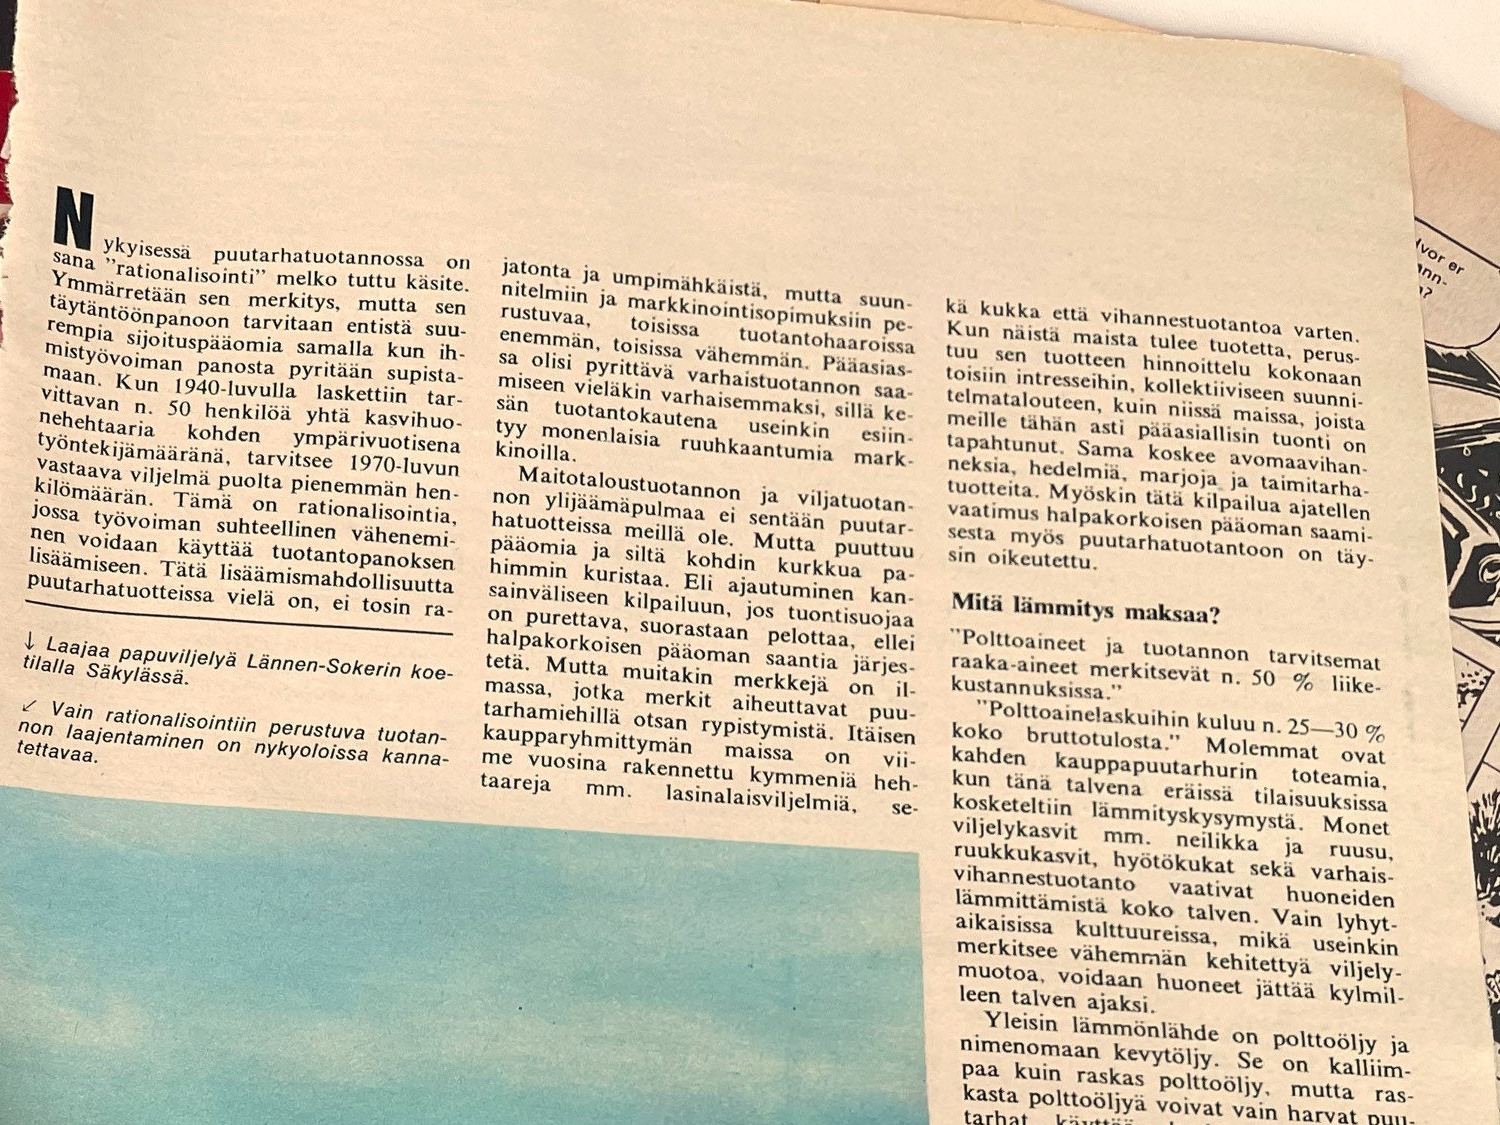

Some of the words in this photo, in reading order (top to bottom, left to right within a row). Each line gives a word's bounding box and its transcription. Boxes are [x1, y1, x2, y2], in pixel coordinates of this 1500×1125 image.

[213, 248, 424, 267] puutarhatuotannossa
[447, 258, 470, 270] on
[502, 257, 571, 279] jatonta
[582, 265, 600, 284] ja
[613, 272, 767, 300] umpimähkäistä,
[786, 289, 842, 304] mutta
[860, 295, 912, 310] suun-
[947, 298, 968, 314] kä
[981, 300, 1040, 319] kukka
[1053, 307, 1088, 321] että
[1101, 308, 1282, 335] vihannestuotantoa
[1294, 326, 1359, 343] varten.
[43, 365, 101, 386] maan.
[116, 373, 158, 392] Kun
[176, 378, 297, 398] 1940-luvulla
[317, 384, 407, 404] laskettiin
[427, 391, 462, 406] tar-
[519, 465, 740, 500] Maitotaloustuotannon
[760, 486, 779, 506] ja
[798, 489, 913, 512] viljatuotan-
[29, 546, 147, 575] lisäämiseen.
[160, 560, 207, 578] Tätä
[220, 564, 454, 594] lisäämismahdollisuutta
[952, 592, 1003, 612] Mitä
[1013, 595, 1114, 622] lämmitys
[1125, 603, 1220, 625] maksaa?
[23, 655, 74, 675] tilalla
[86, 663, 188, 685] Säkylässä.
[47, 636, 109, 658] Laajaa
[119, 649, 236, 669] papuviljelyä
[247, 653, 401, 677] Lännen-Sokerin
[411, 665, 453, 680] koe-
[18, 721, 53, 736] non
[66, 724, 204, 750] laajentaminen
[218, 740, 241, 752] on
[254, 741, 368, 761] nykyoloissa
[382, 748, 449, 766] kanna-
[53, 701, 93, 720] Vain
[106, 709, 256, 733] rationalisointiin
[268, 723, 365, 740] perustuva
[378, 727, 447, 744] tuotan-
[17, 740, 97, 763] tettavaa.
[481, 773, 551, 795] taareja
[586, 783, 631, 797] mm.
[666, 784, 856, 814] lasinalaisviljelmiä,
[892, 803, 918, 815] se-
[984, 1010, 1058, 1032] Yleisin
[1073, 1016, 1219, 1042] lämmönlähde
[1232, 1032, 1258, 1044] on
[1273, 1031, 1377, 1055] polttoöljy
[1391, 1035, 1410, 1057] ja
